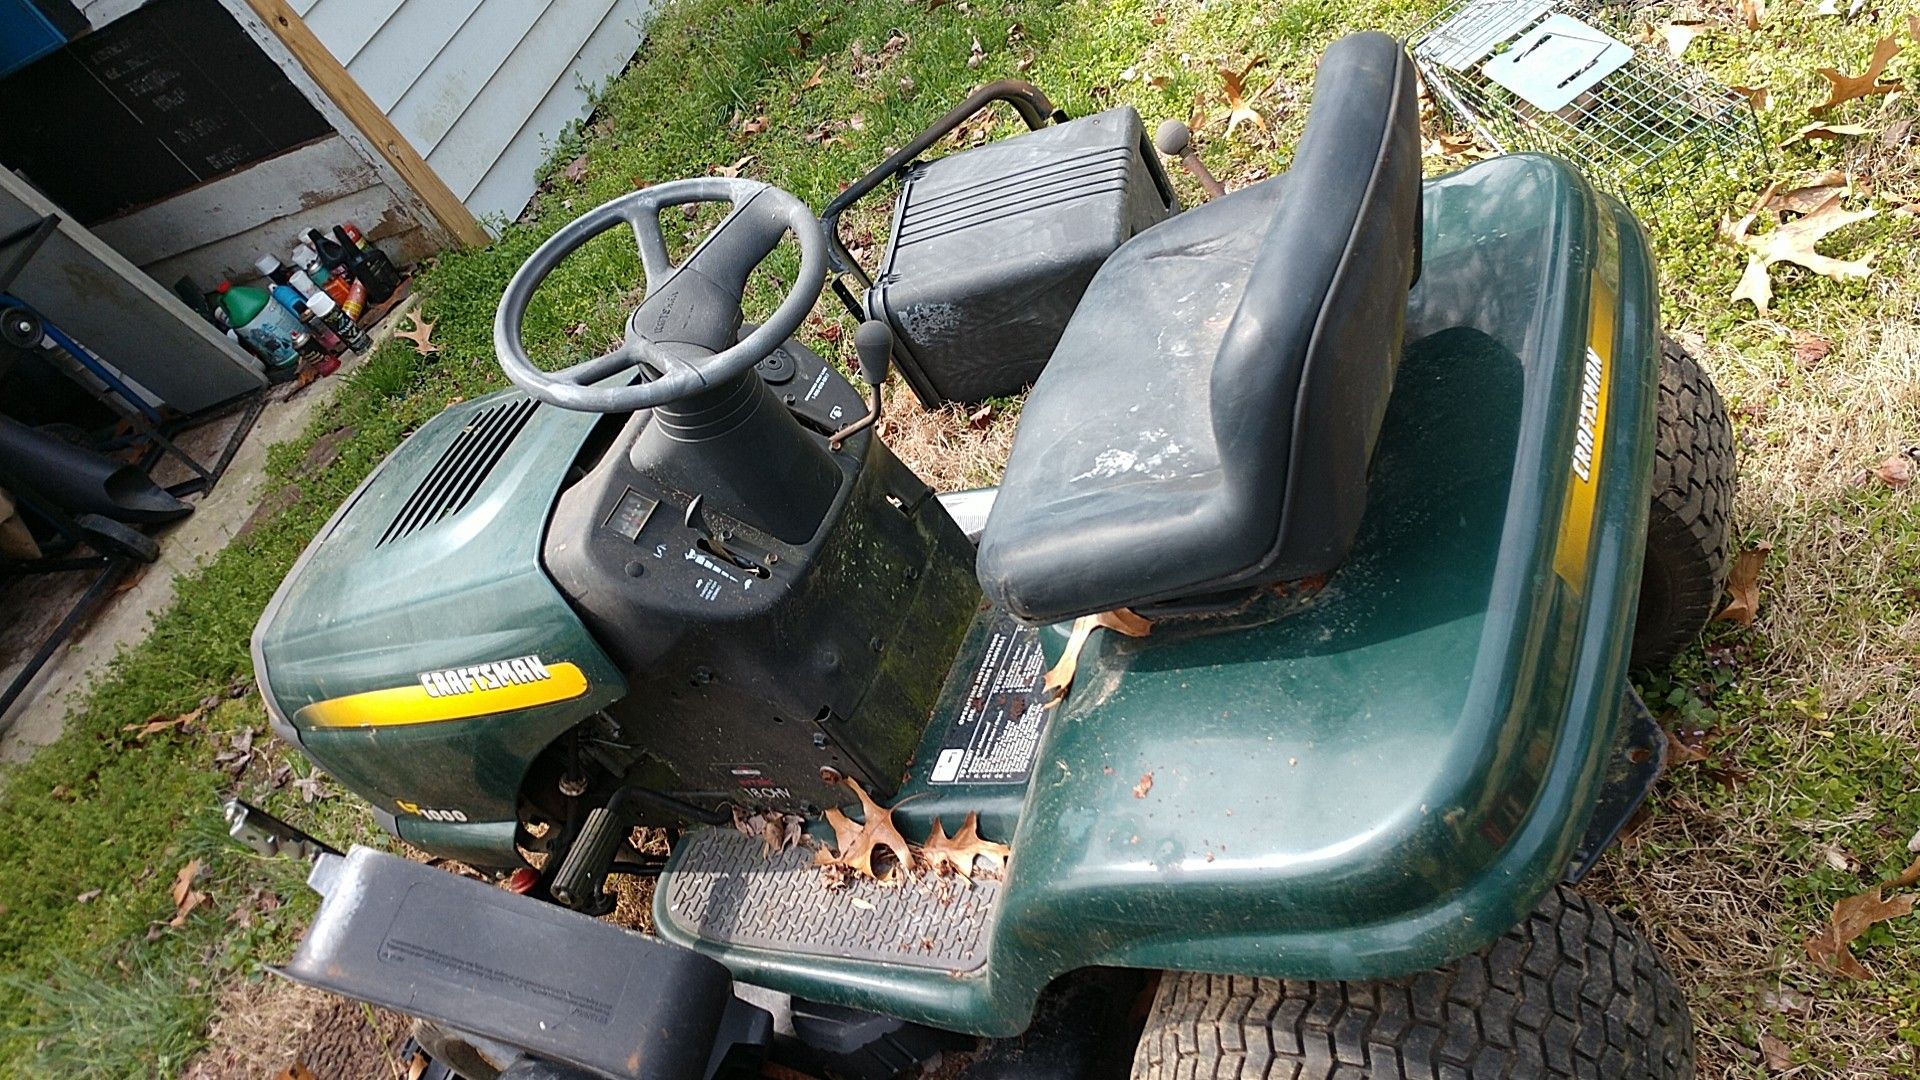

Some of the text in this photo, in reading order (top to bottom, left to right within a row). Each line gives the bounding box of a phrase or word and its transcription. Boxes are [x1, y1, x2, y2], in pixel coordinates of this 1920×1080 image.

[1572, 345, 1603, 484] CRAFTSMAN
[419, 655, 552, 698] CRAFTSMAN
[957, 632, 1000, 725] OPERATING INSTRUCTIONS
